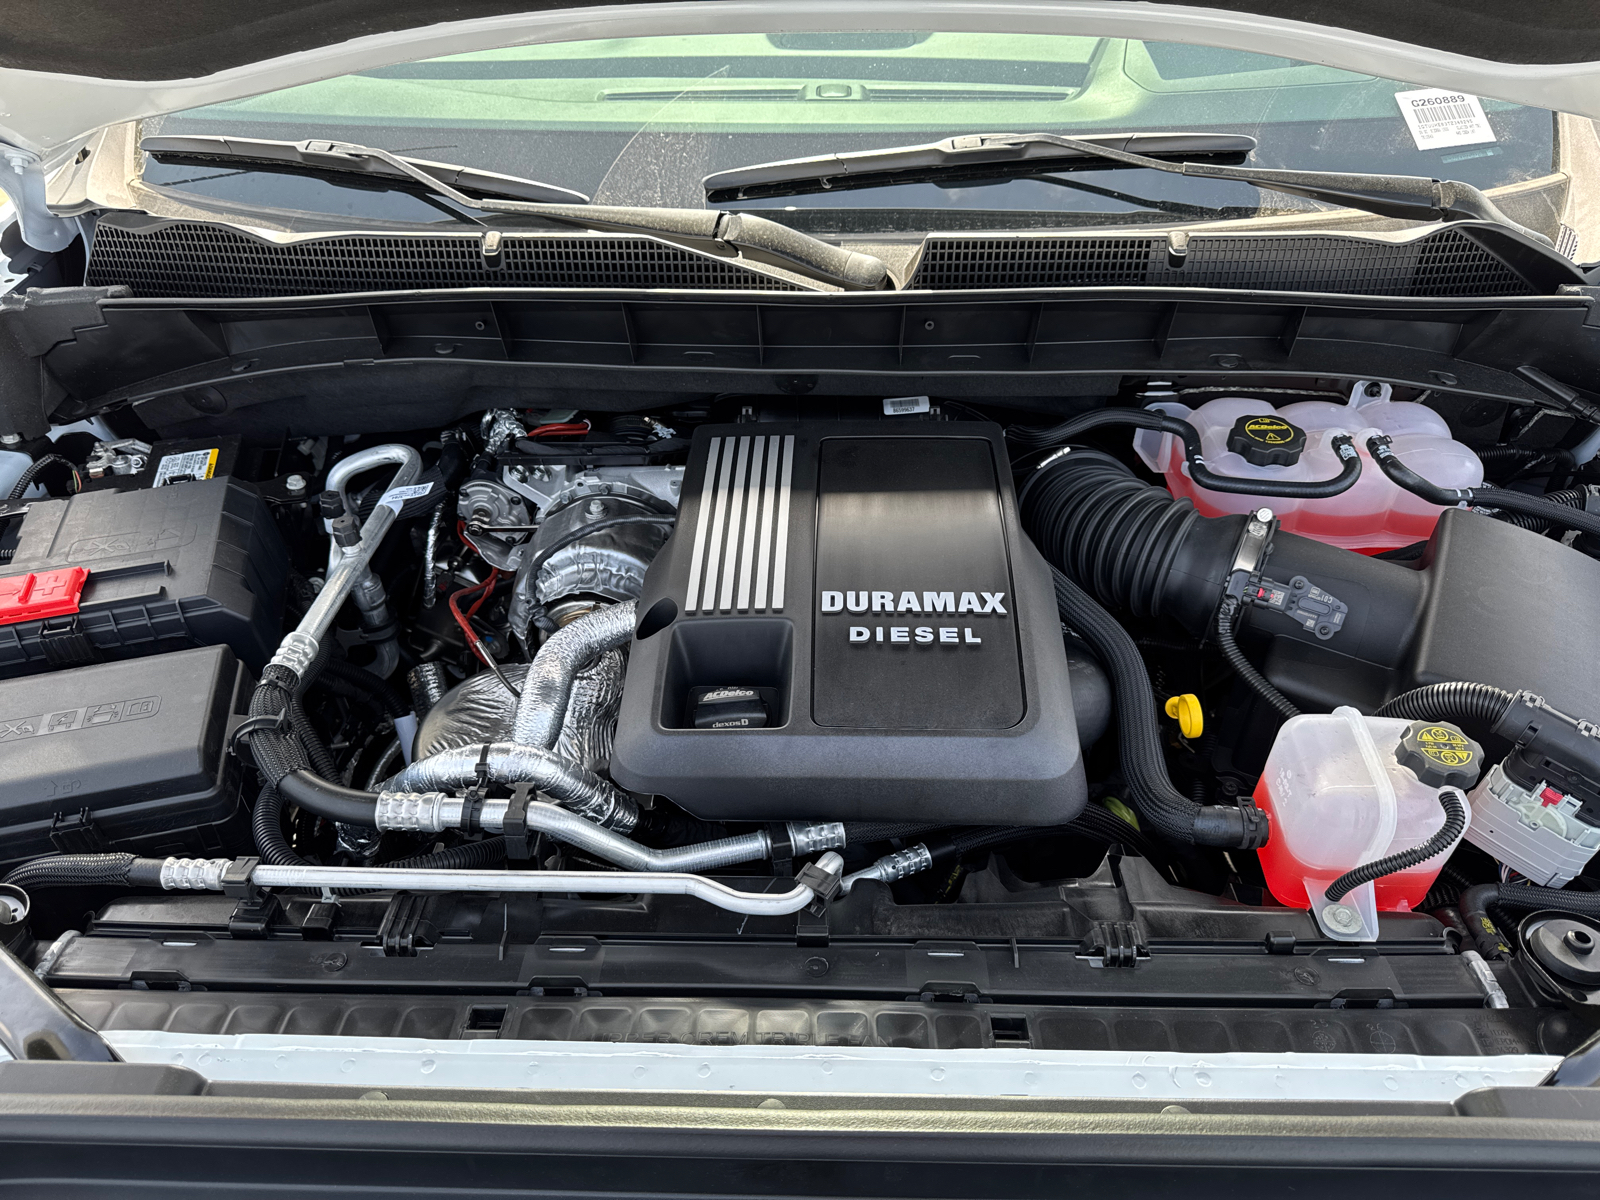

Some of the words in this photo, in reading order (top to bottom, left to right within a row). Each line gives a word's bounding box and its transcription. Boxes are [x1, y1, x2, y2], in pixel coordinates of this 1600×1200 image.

[1411, 95, 1465, 108] G260889
[821, 590, 1008, 615] DURAMAX
[849, 626, 982, 645] DIESEL
[703, 689, 754, 702] ACDelco
